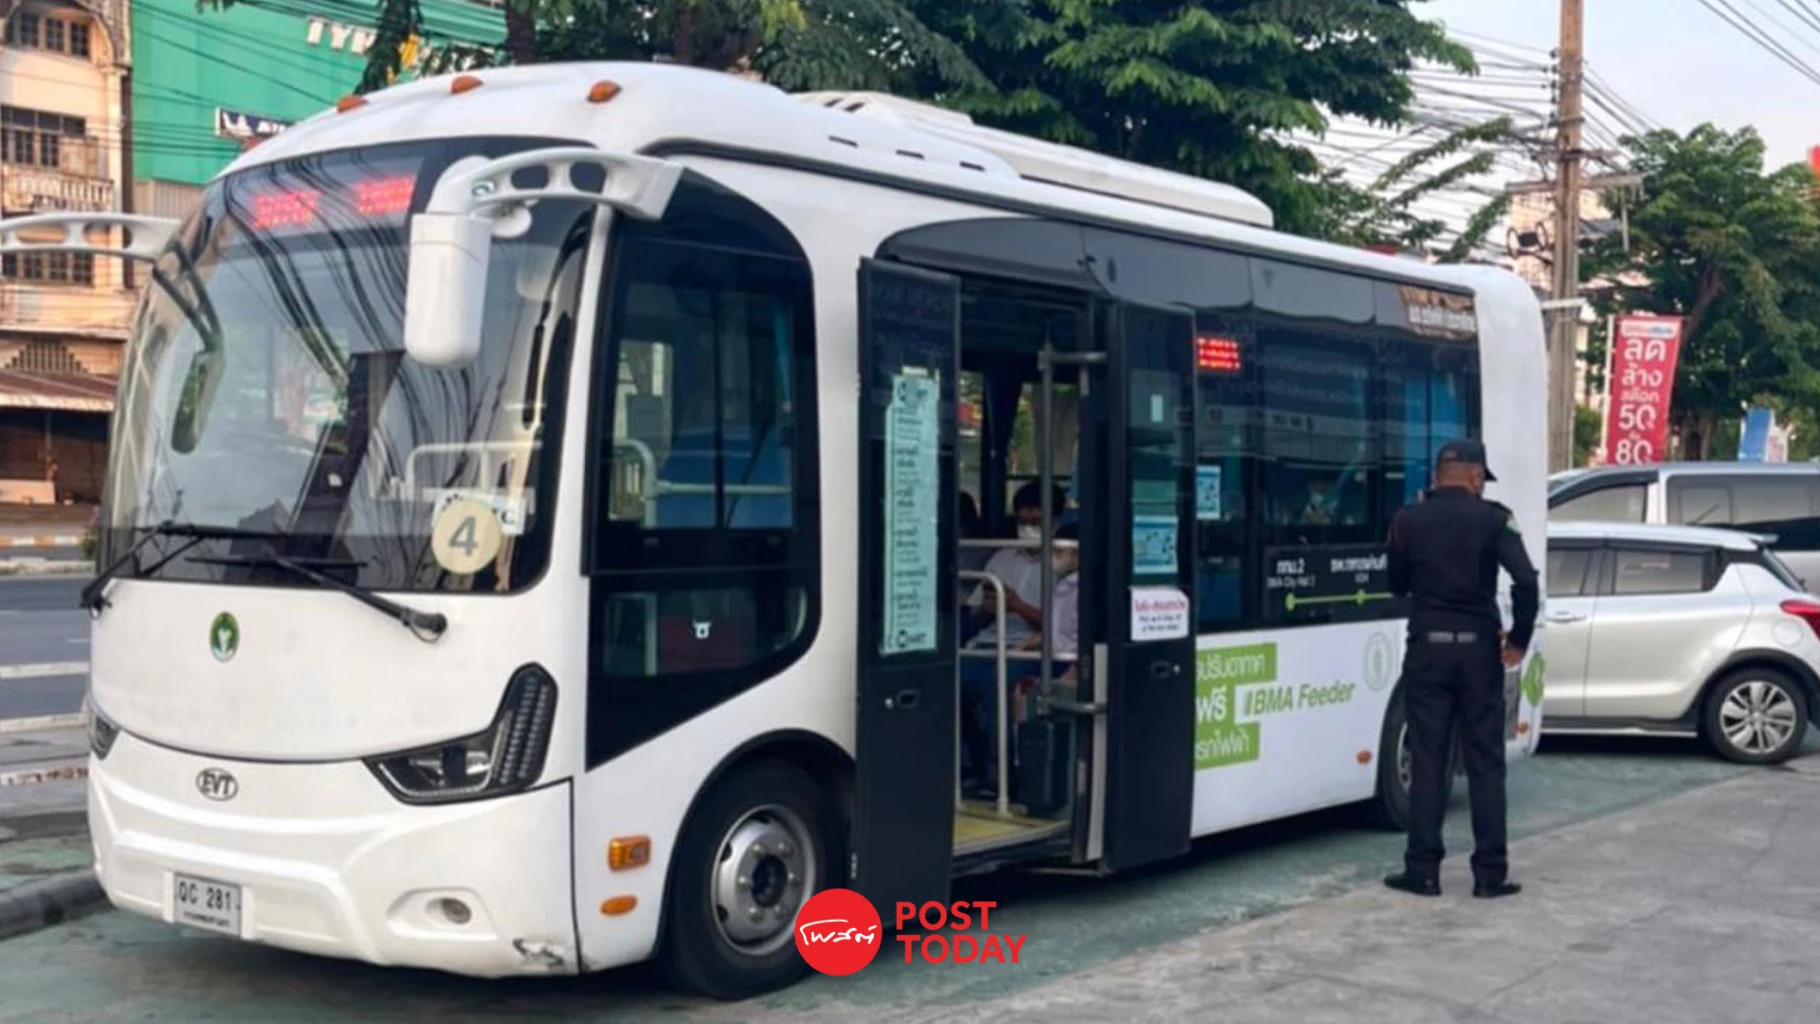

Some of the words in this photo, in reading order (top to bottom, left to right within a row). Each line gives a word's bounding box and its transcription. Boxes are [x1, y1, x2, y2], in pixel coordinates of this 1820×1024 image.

[1623, 338, 1667, 361] ลด
[1621, 361, 1664, 388] ล้าง
[448, 516, 479, 557] 4
[1297, 680, 1357, 709] Feeder
[199, 770, 234, 796] EVT
[206, 886, 232, 912] 281
